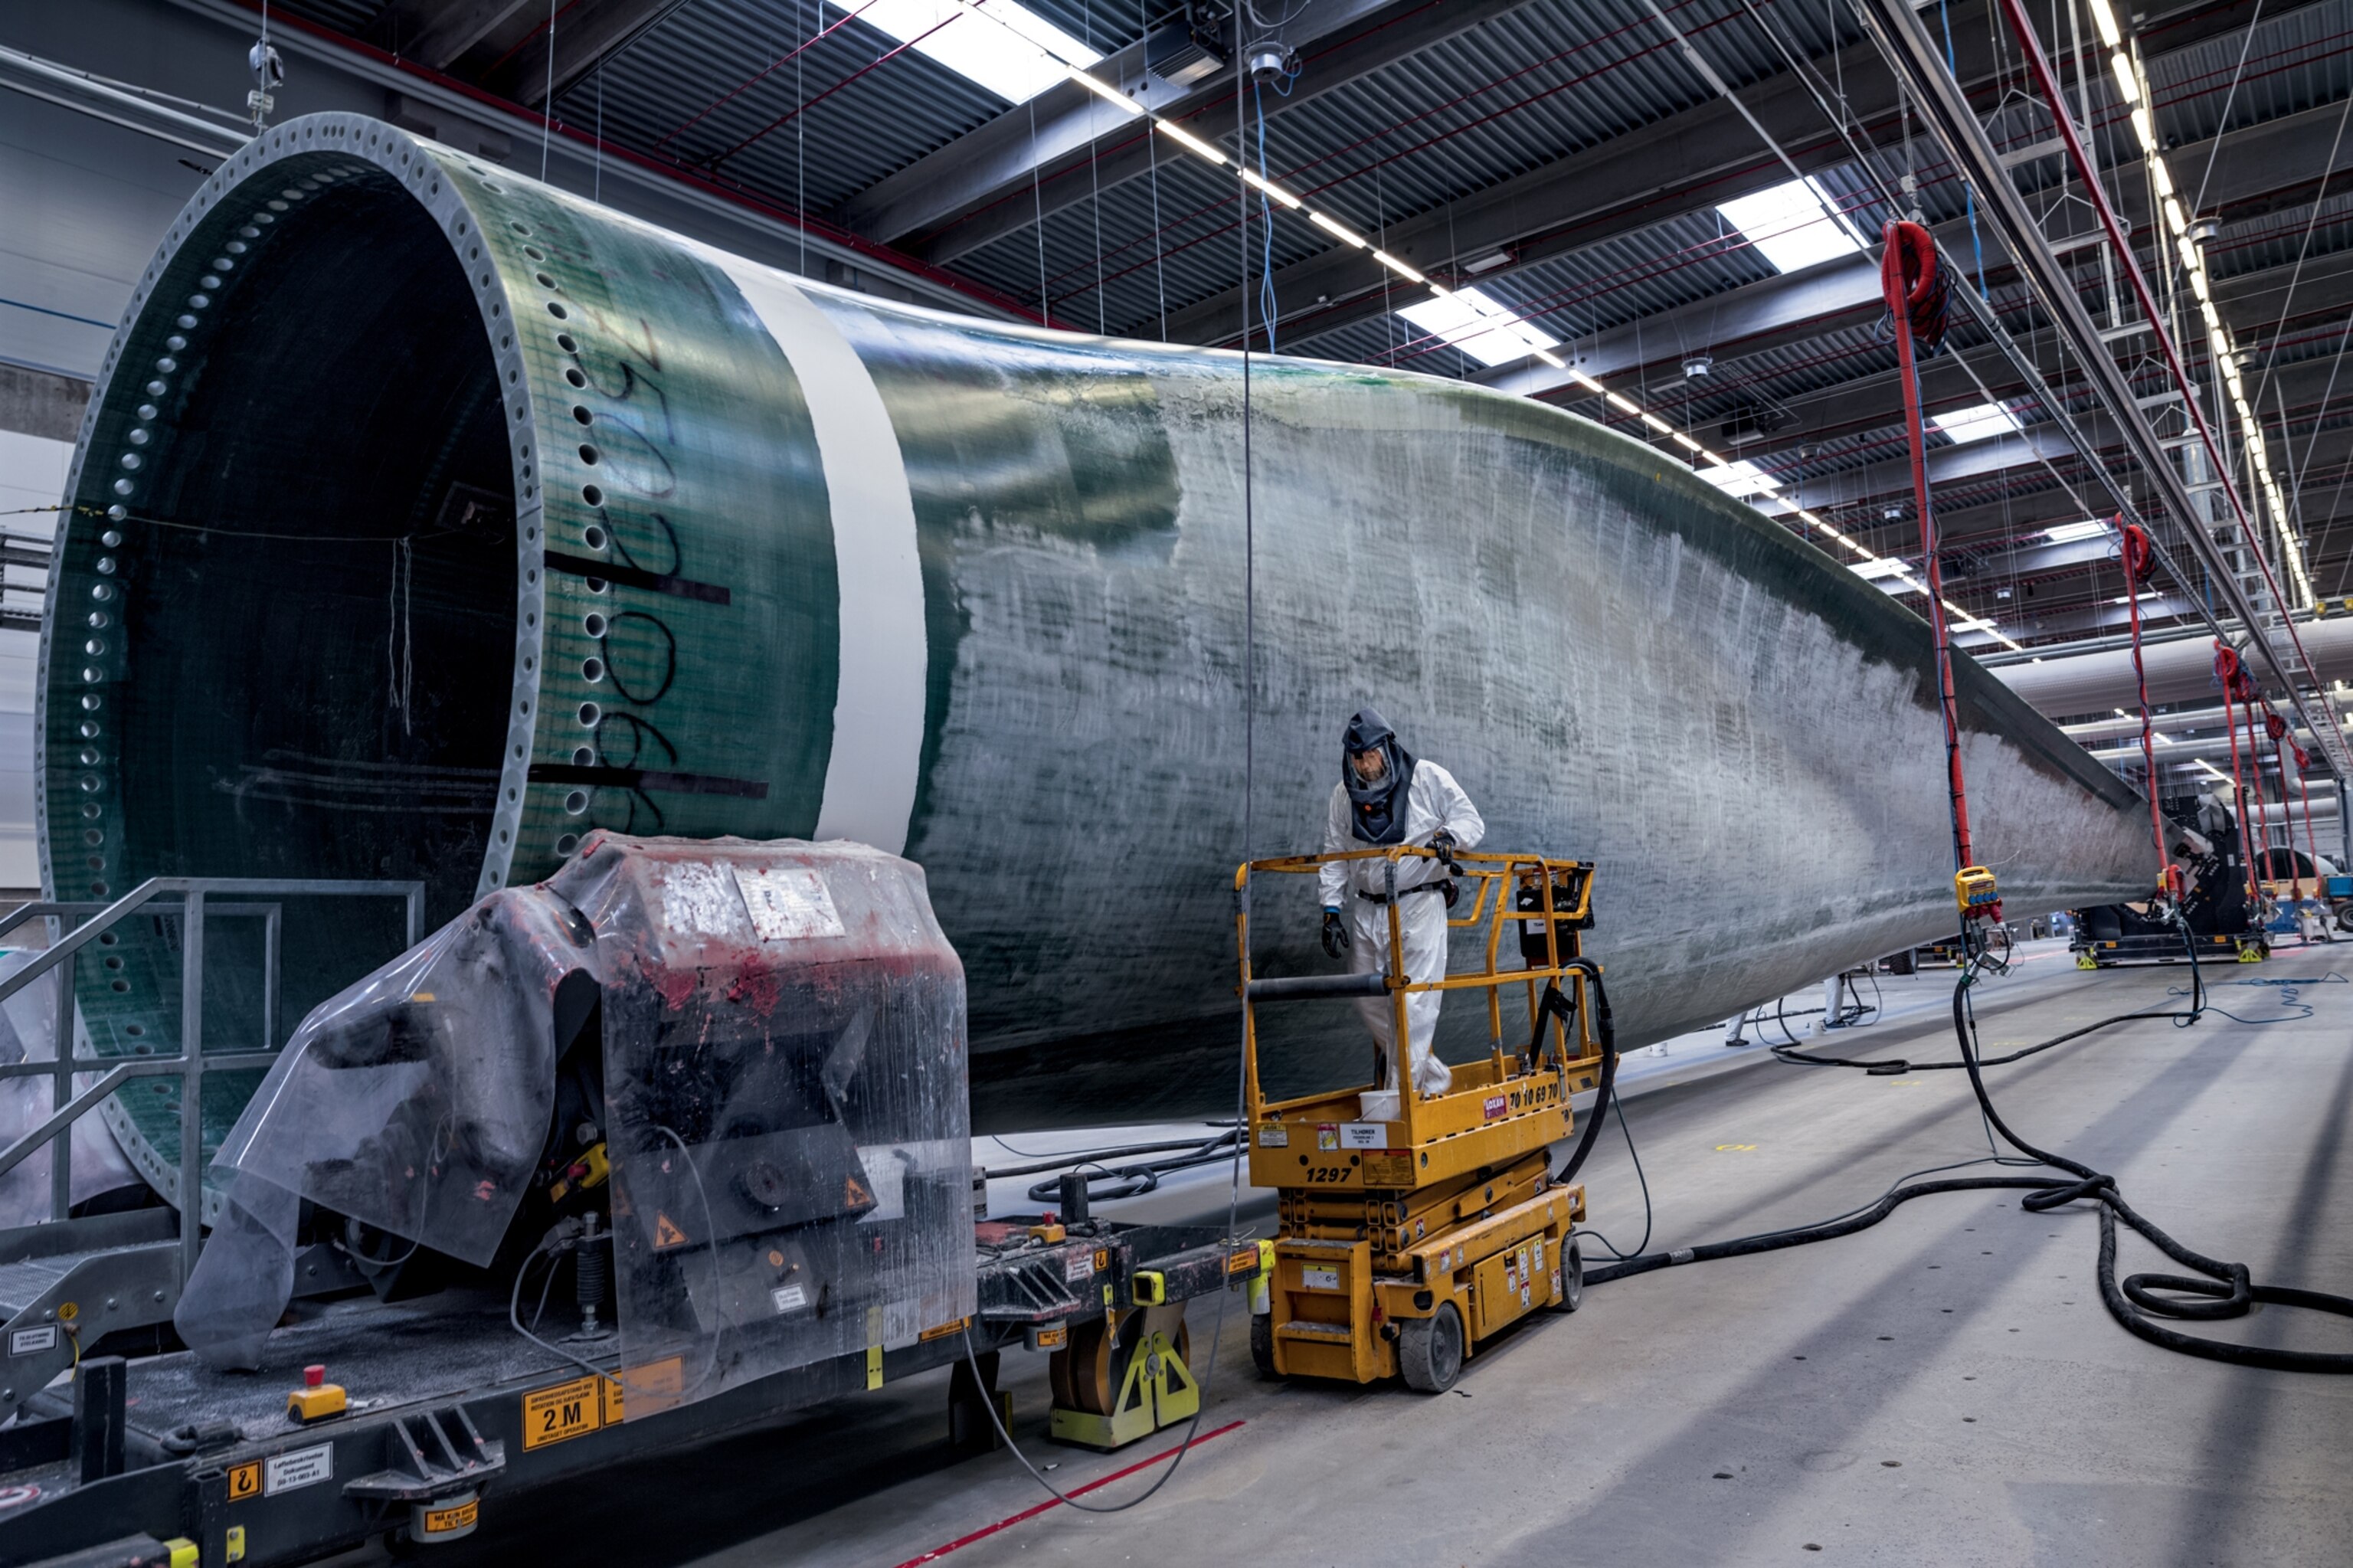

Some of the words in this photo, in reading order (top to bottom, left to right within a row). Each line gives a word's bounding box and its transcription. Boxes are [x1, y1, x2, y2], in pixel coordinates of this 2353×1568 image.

[1510, 1092, 1520, 1108] 70
[1523, 1088, 1533, 1106] 10
[1536, 1085, 1546, 1104] 69
[1548, 1082, 1558, 1100] 70
[1485, 1097, 1504, 1111] LOXAM
[1307, 1167, 1352, 1183] 1297
[543, 1409, 556, 1432] 2
[562, 1401, 581, 1427] M
[283, 1462, 314, 1475] Dokument
